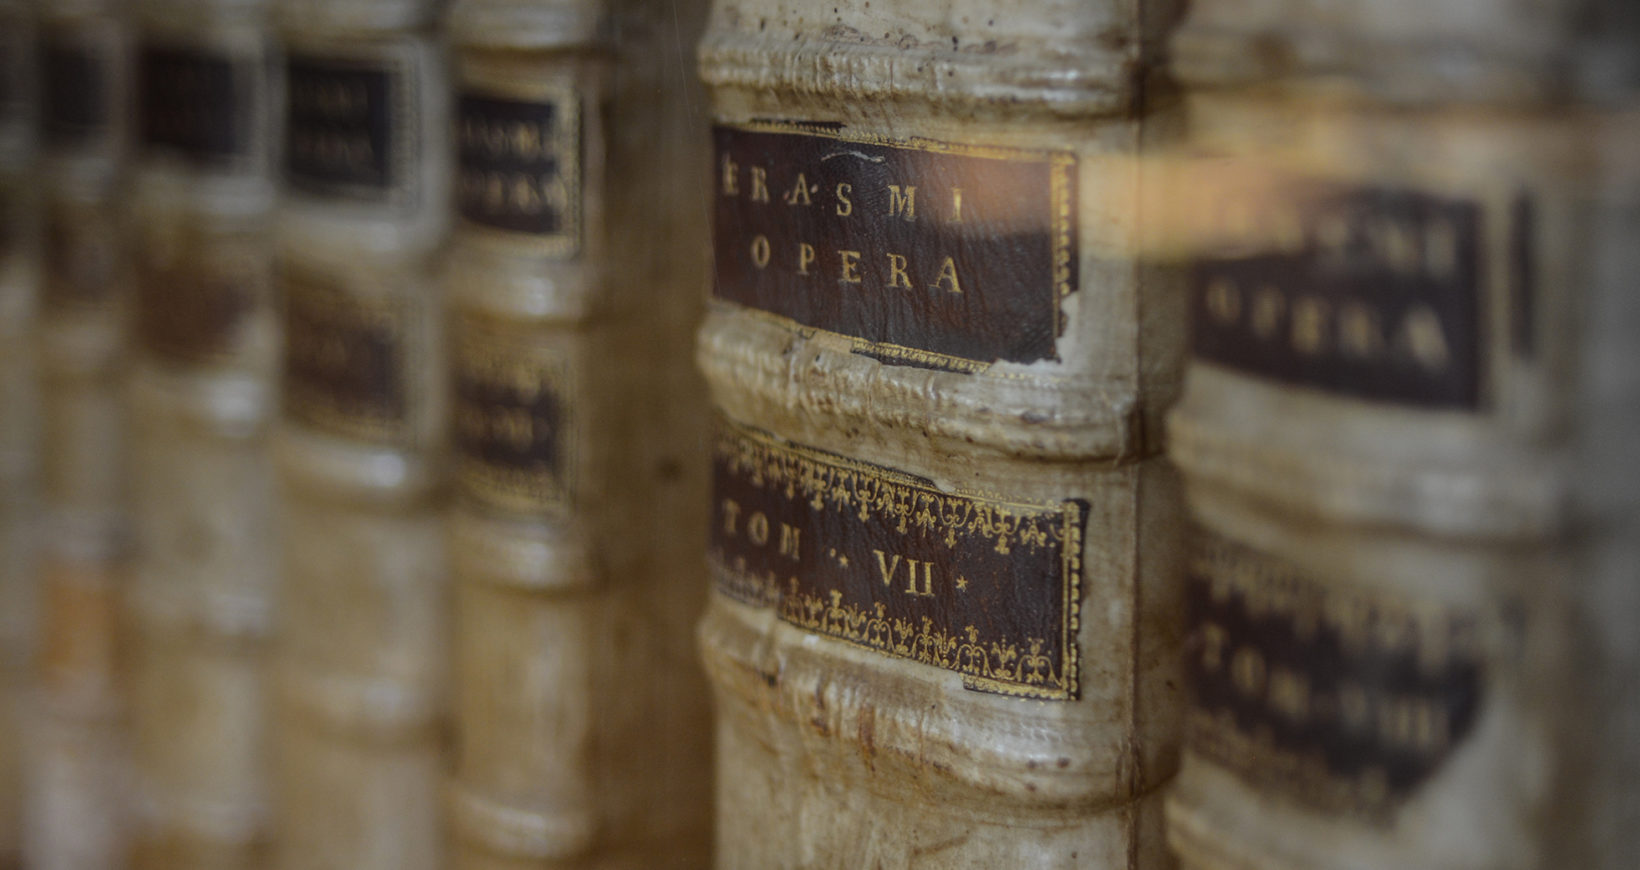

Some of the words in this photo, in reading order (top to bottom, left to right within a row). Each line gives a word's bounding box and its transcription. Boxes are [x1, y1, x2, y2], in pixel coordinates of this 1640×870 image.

[721, 152, 965, 224] ERASMI
[749, 233, 964, 295] OPERA
[720, 498, 801, 561] TOM
[872, 548, 937, 599] VII
